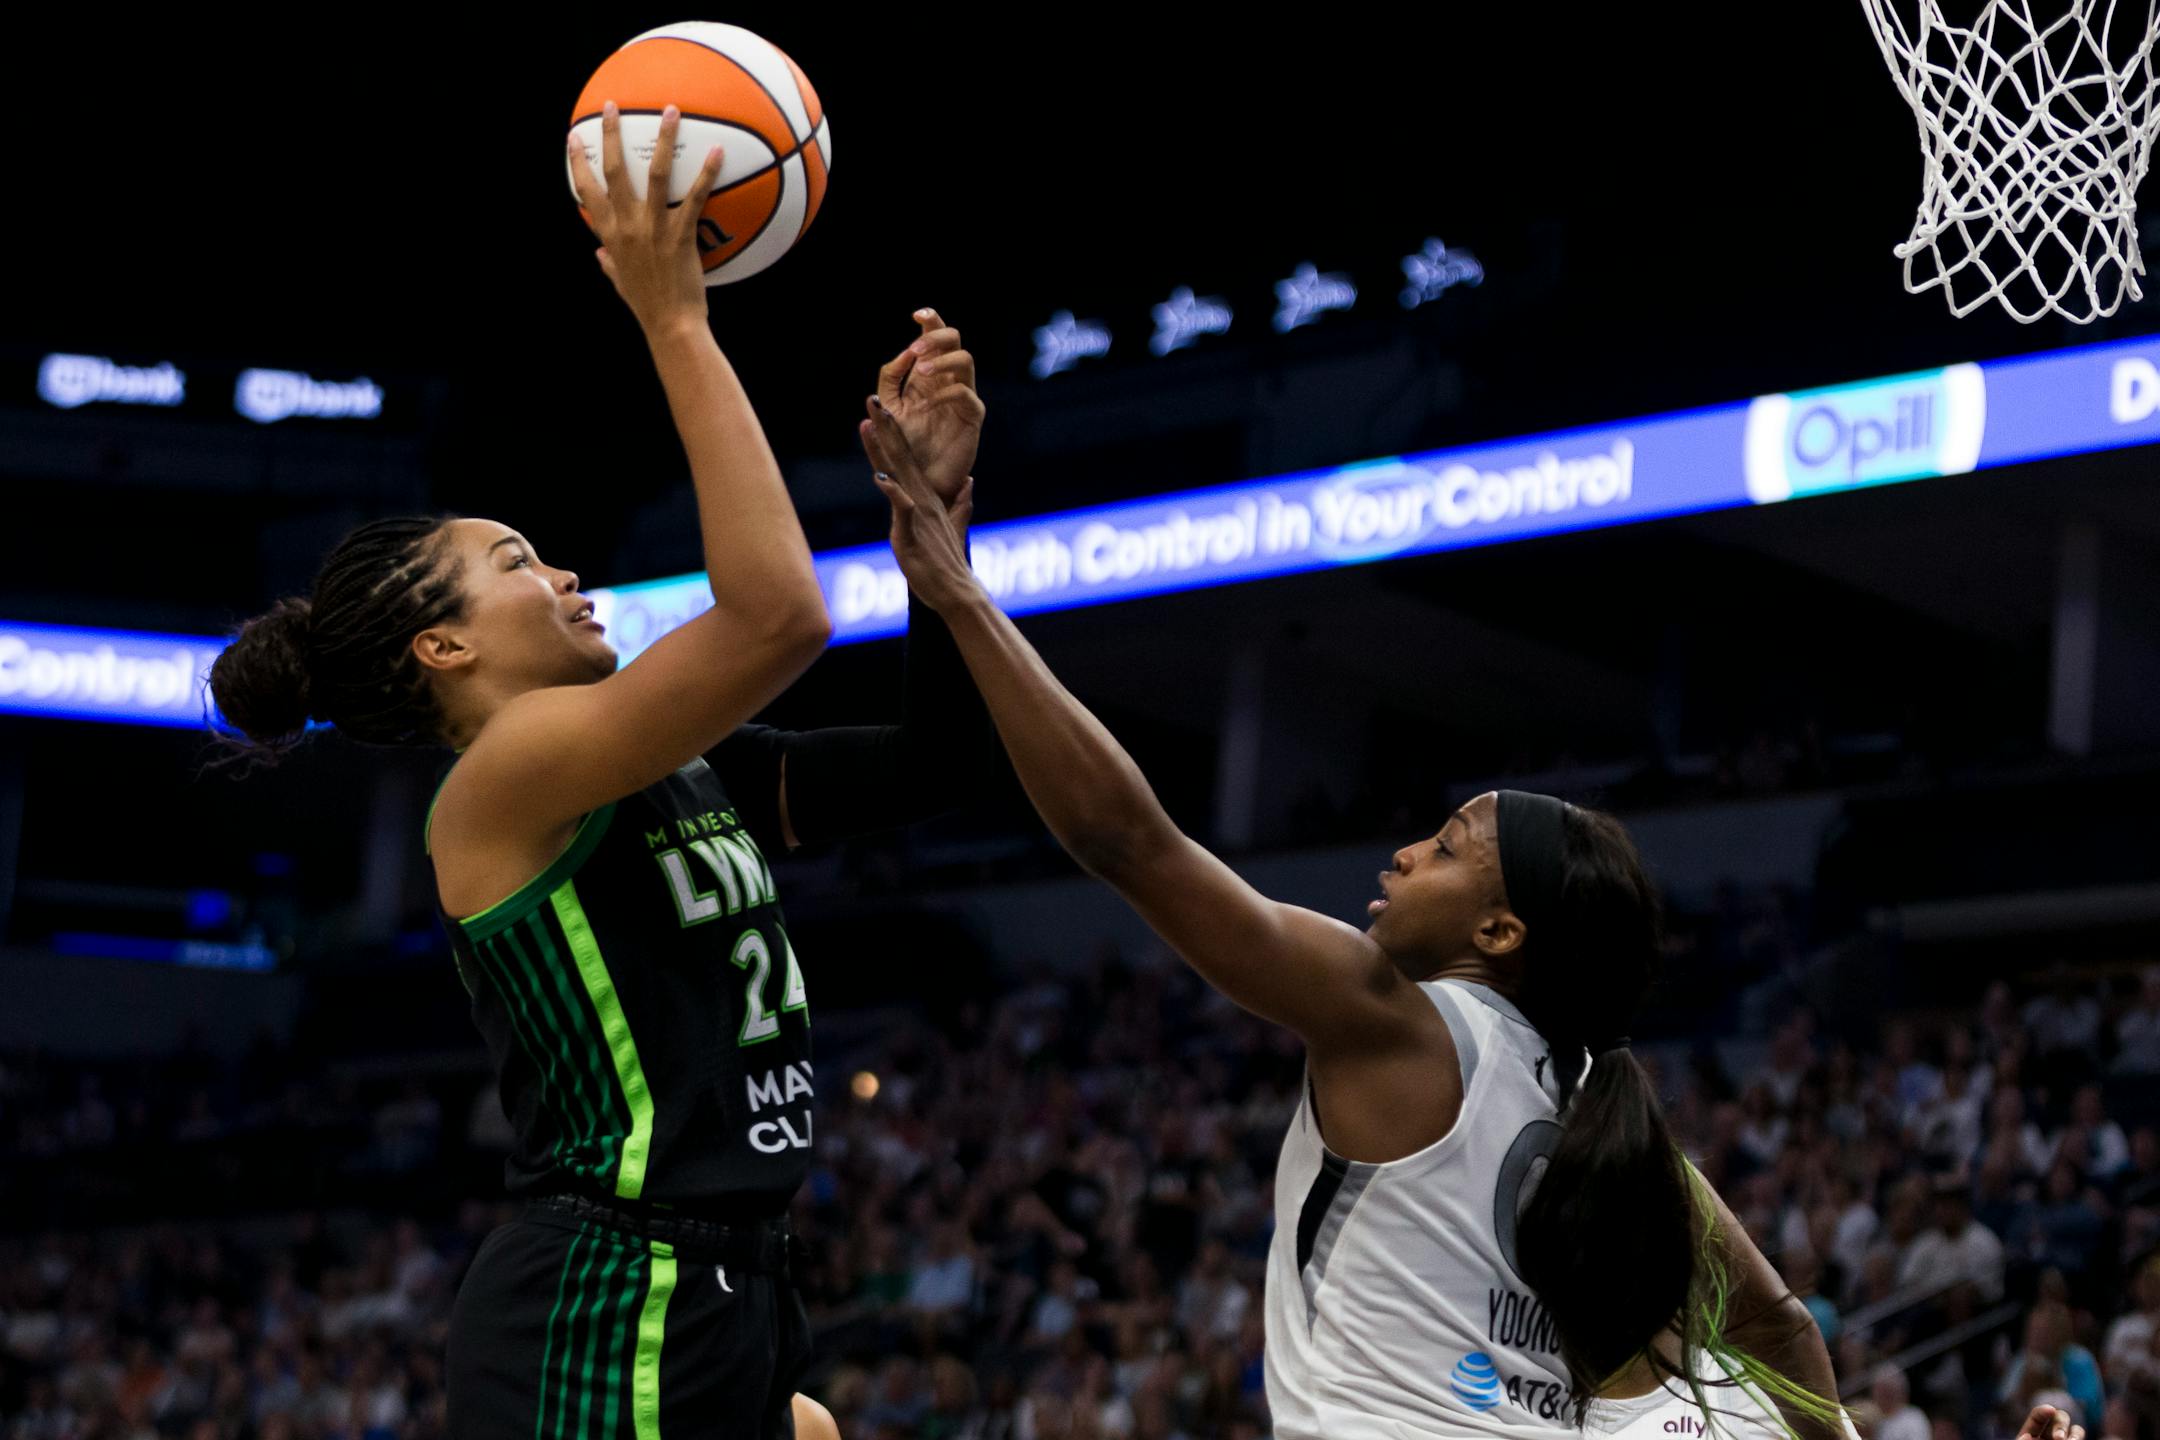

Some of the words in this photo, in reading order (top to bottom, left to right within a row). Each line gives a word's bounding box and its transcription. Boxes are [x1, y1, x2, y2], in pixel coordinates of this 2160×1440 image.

[1793, 392, 1933, 487] Opill
[1074, 497, 1257, 584] Control
[1313, 483, 1432, 544] Your
[1433, 437, 1634, 528] Control
[1663, 1416, 1706, 1438] ally
